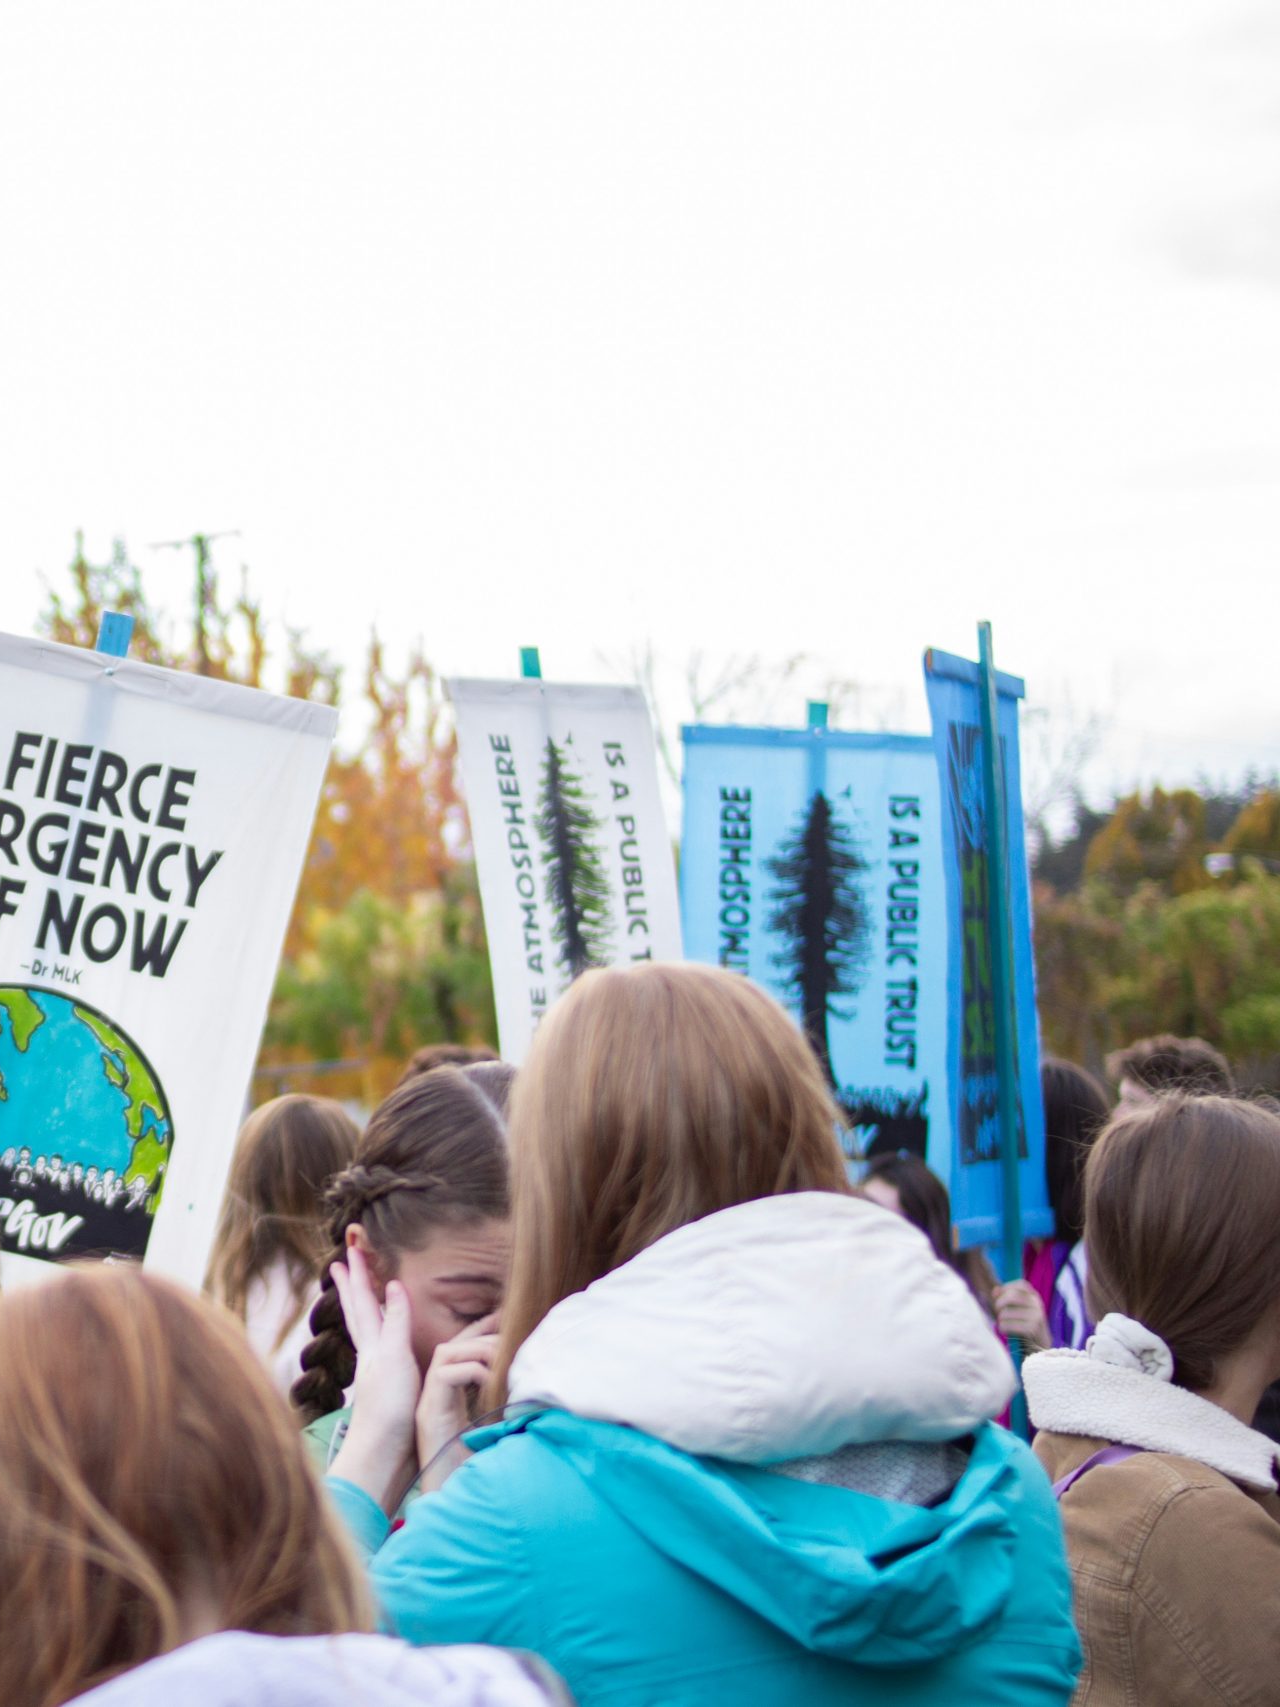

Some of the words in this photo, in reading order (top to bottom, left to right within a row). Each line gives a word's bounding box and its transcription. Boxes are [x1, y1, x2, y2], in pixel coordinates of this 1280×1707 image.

[2, 730, 197, 832] FIERCE
[603, 741, 626, 768] IS
[611, 780, 630, 802] A
[489, 733, 544, 974] ATMOSPHERE
[888, 828, 920, 850] A
[889, 795, 920, 821] IS
[616, 816, 649, 936] PUBLIC
[719, 785, 751, 976] TMOSPHERE
[886, 860, 920, 968] PUBLIC
[33, 887, 189, 978] NOW
[51, 962, 83, 984] MLK
[884, 976, 920, 1070] TRUST
